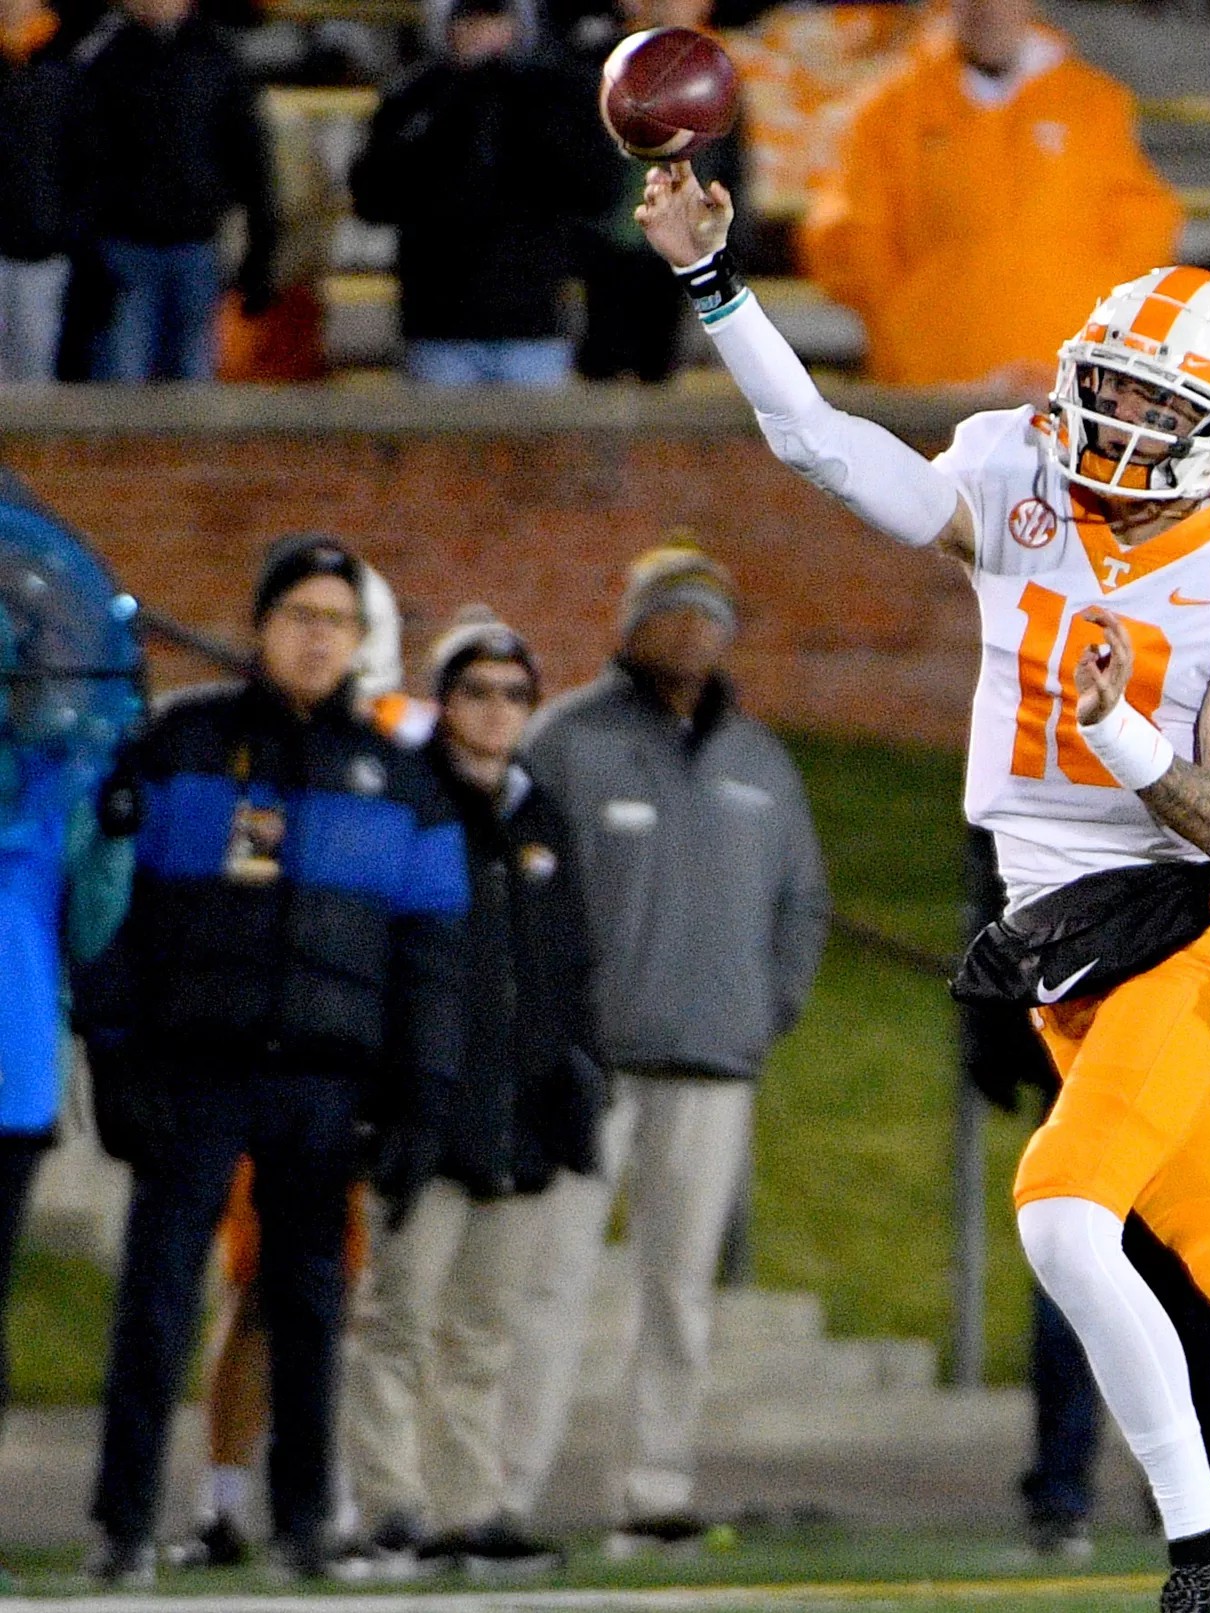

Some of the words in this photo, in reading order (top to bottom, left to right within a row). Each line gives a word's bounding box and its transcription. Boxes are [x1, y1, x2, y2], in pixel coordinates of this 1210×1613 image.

[1012, 500, 1056, 546] SEC
[1102, 555, 1131, 588] T
[1010, 580, 1173, 788] 10
